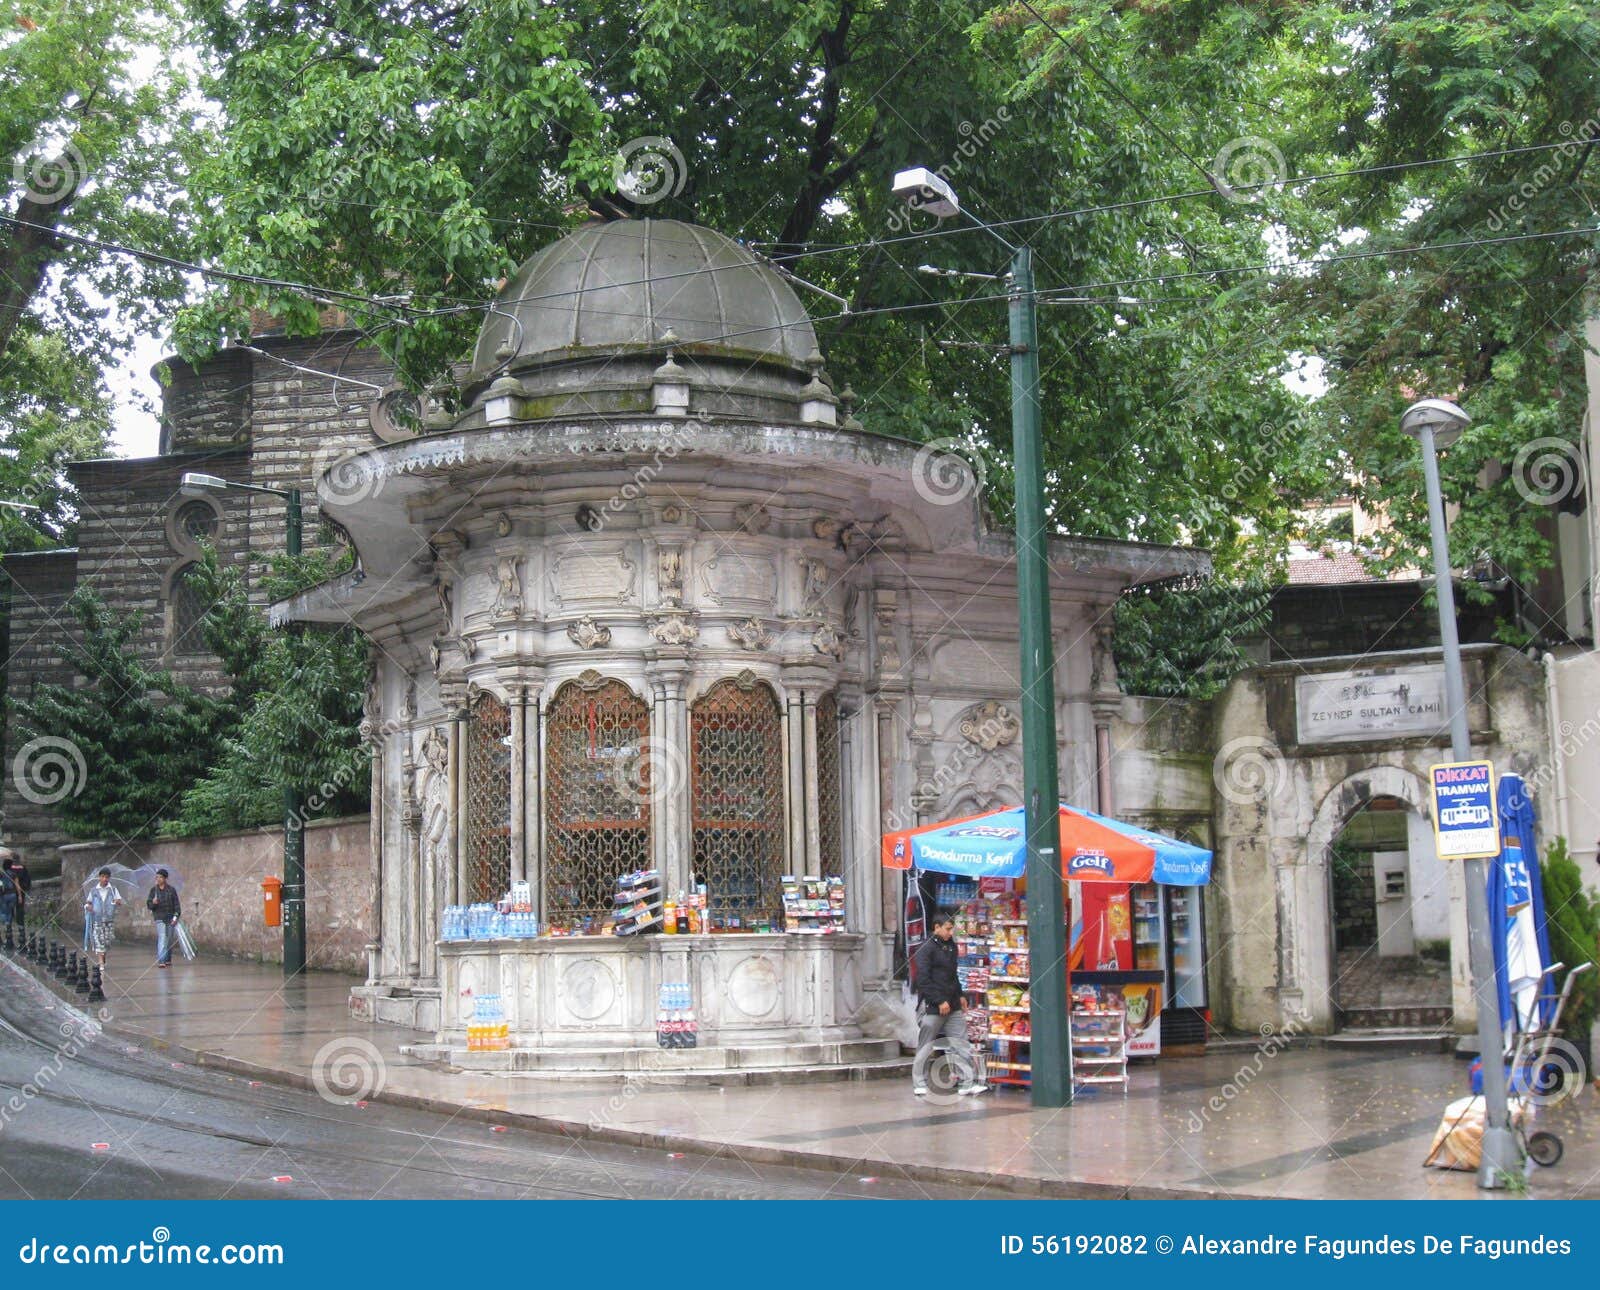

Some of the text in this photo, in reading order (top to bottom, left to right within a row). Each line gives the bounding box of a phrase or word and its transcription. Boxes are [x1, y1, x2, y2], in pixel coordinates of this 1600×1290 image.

[1312, 710, 1353, 721] ZEYNEP
[1360, 707, 1400, 718] SULTAN
[1436, 767, 1488, 783] DİKKAT
[1436, 783, 1489, 796] TRAMVAY
[920, 845, 1014, 866] Dondurma Keyfi
[1072, 856, 1109, 870] Golf
